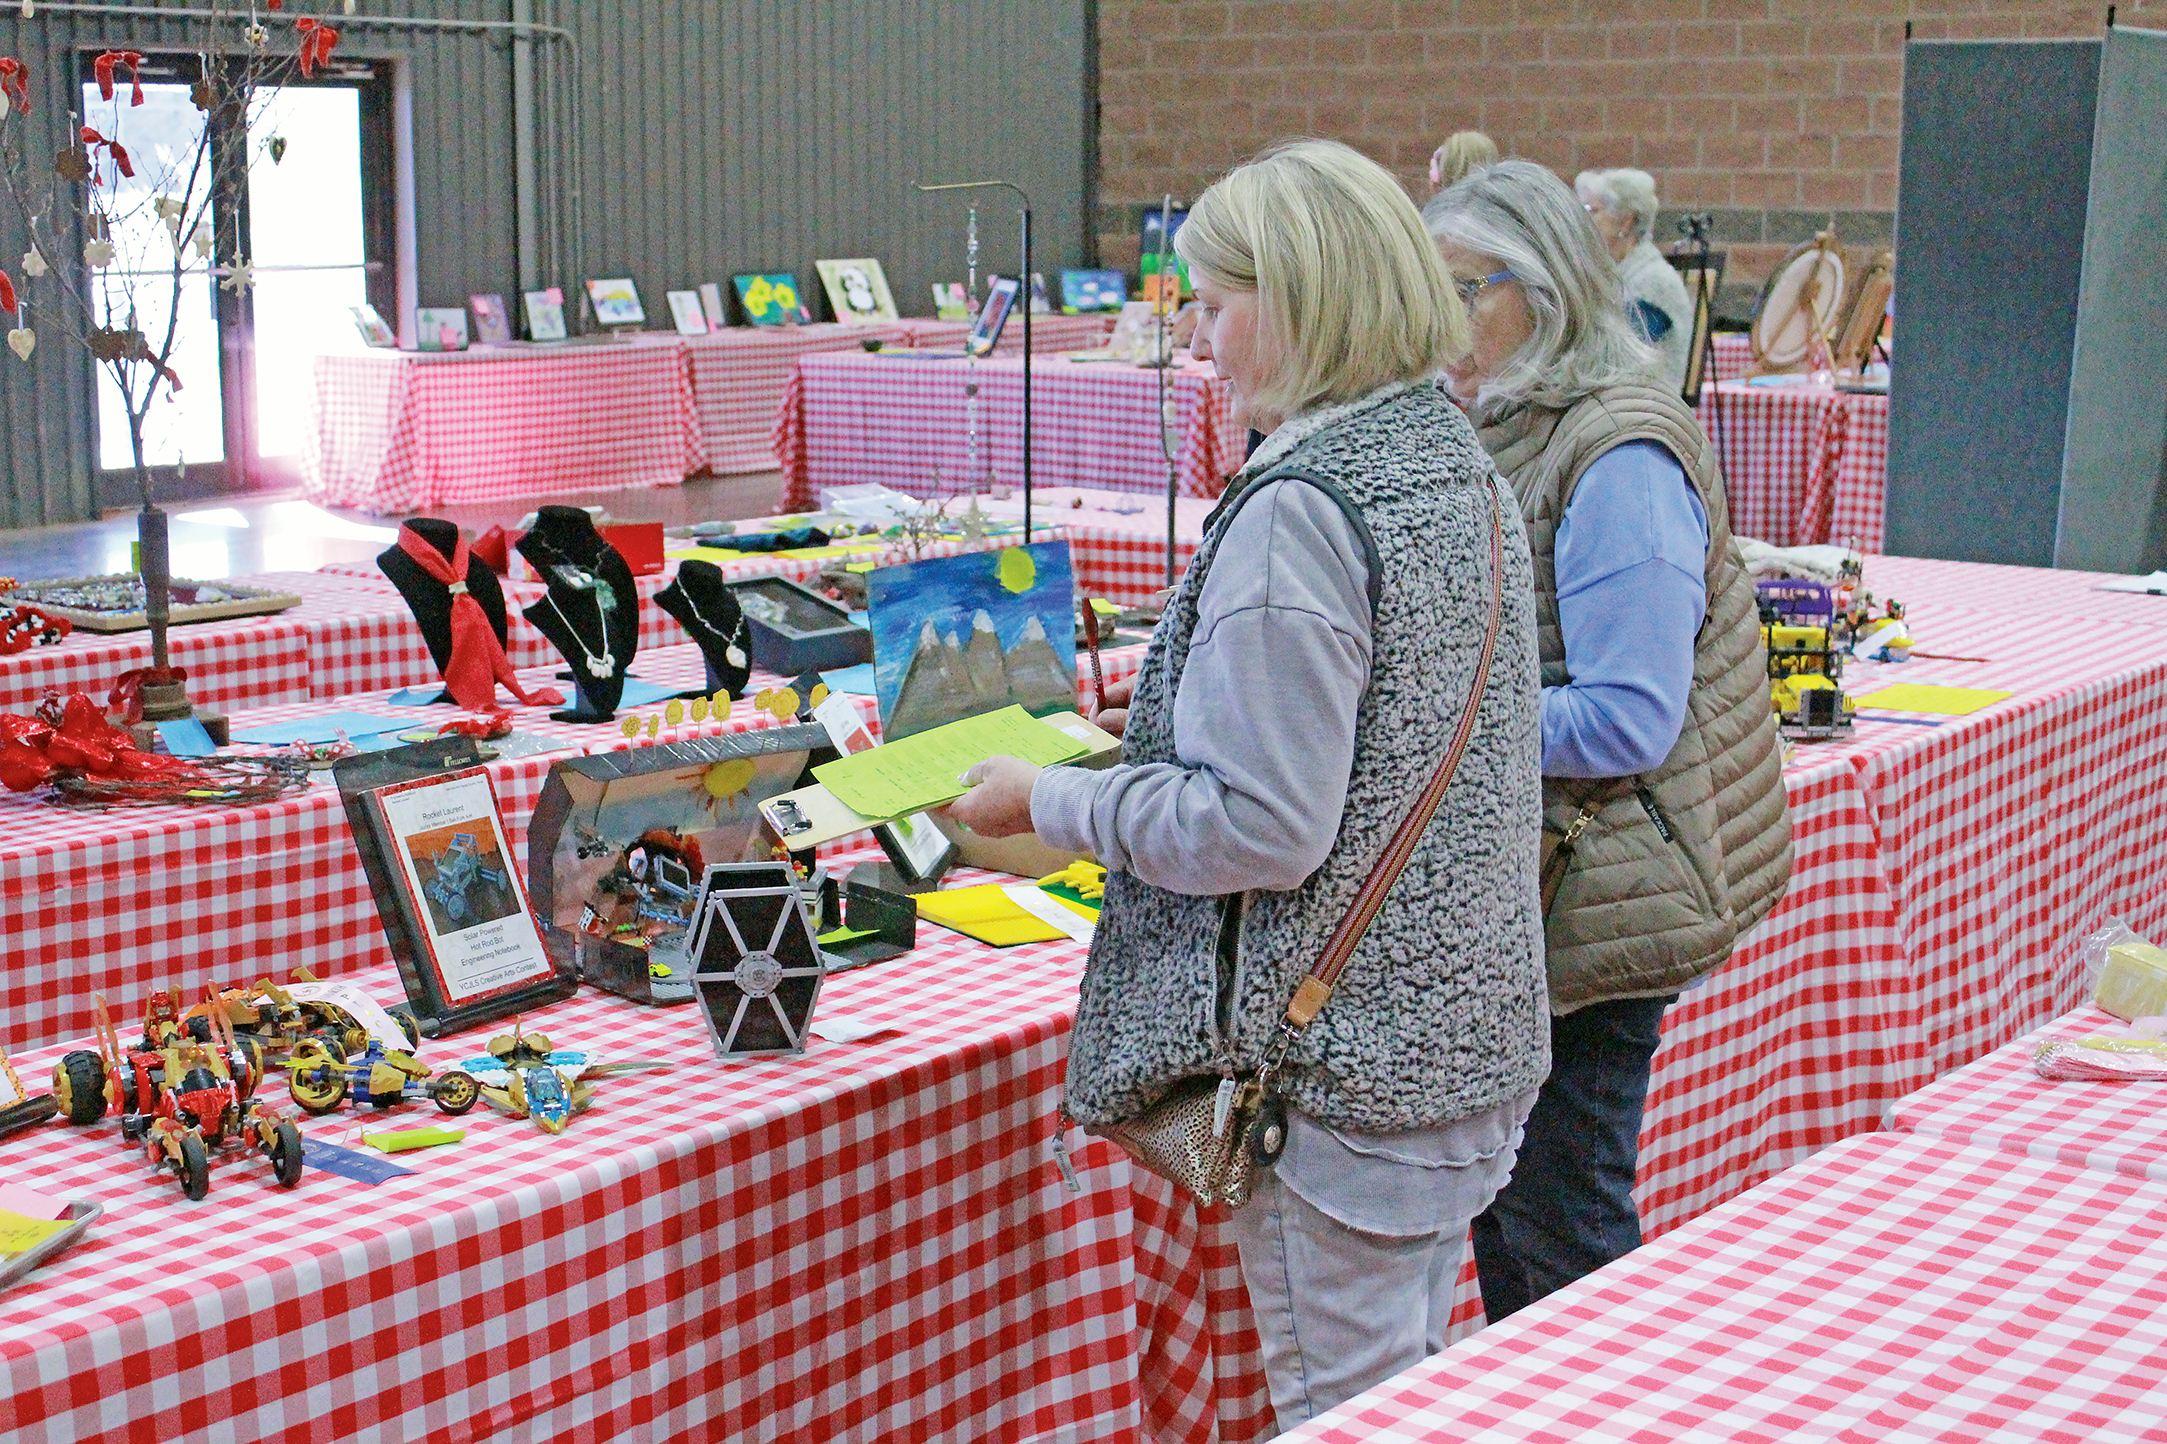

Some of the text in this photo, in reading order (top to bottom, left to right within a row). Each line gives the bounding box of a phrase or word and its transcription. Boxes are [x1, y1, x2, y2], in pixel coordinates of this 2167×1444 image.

[422, 809, 443, 820] Rocket
[1648, 804, 1669, 837] PACKABLE
[463, 924, 503, 941] Solar Powered
[470, 936, 505, 951] Hot Rod Bot
[461, 944, 521, 967] Engineering Notebook
[480, 974, 503, 985] Creative
[504, 969, 515, 978] Arts
[516, 962, 538, 974] Contest
